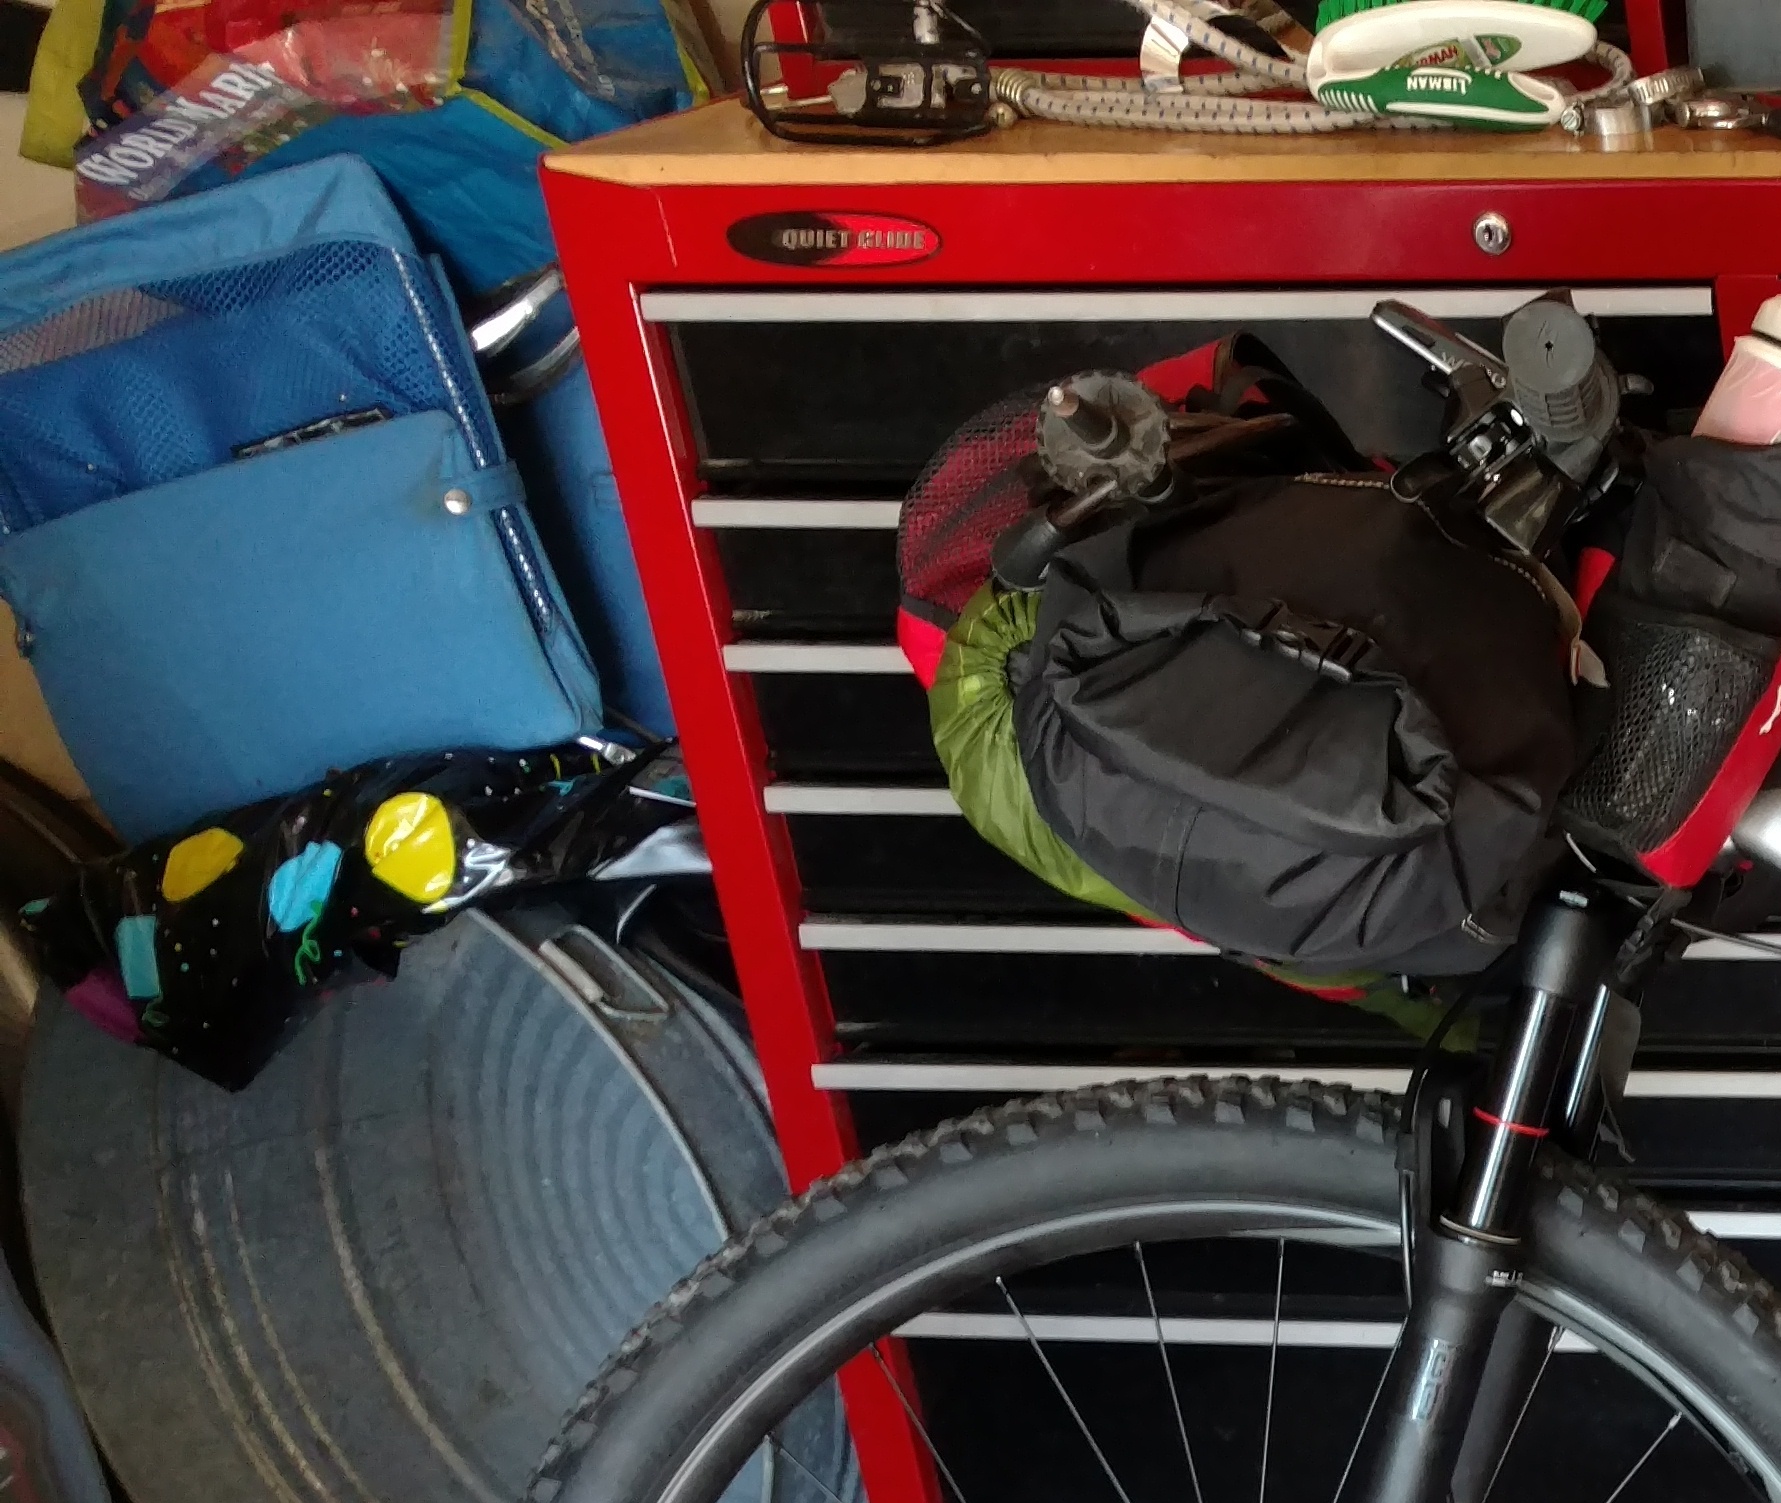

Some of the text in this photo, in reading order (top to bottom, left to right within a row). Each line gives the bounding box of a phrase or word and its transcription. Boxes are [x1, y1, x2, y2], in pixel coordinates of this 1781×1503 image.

[1406, 74, 1467, 96] LIBMAN
[77, 118, 198, 185] WORLD
[782, 228, 927, 251] QUIET GLIDE
